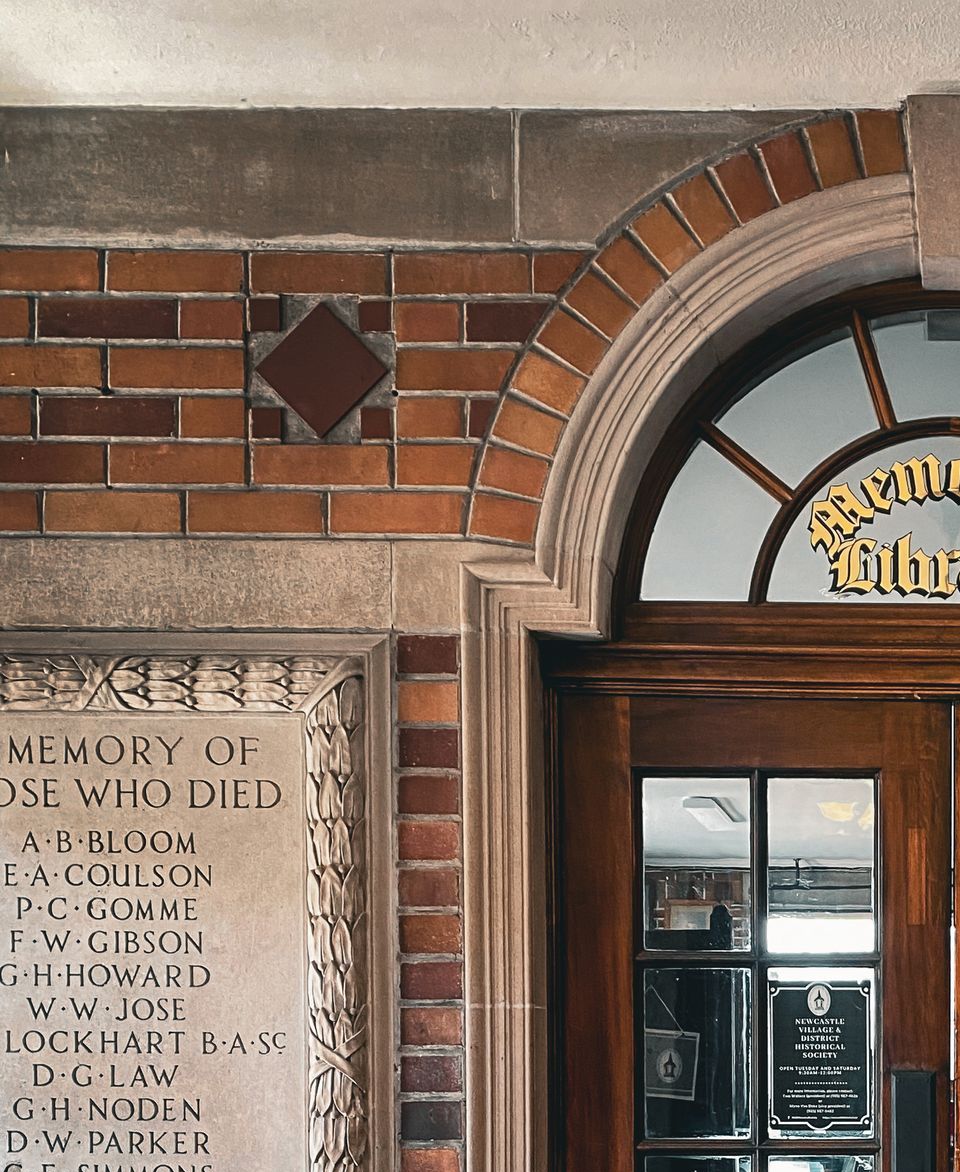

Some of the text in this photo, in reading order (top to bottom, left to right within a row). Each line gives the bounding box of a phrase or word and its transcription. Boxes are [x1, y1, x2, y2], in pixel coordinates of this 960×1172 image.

[8, 736, 259, 765] MEMORY OF
[74, 779, 171, 808] WHO
[188, 780, 281, 809] DIED
[6, 1031, 185, 1054] LOCKHART
